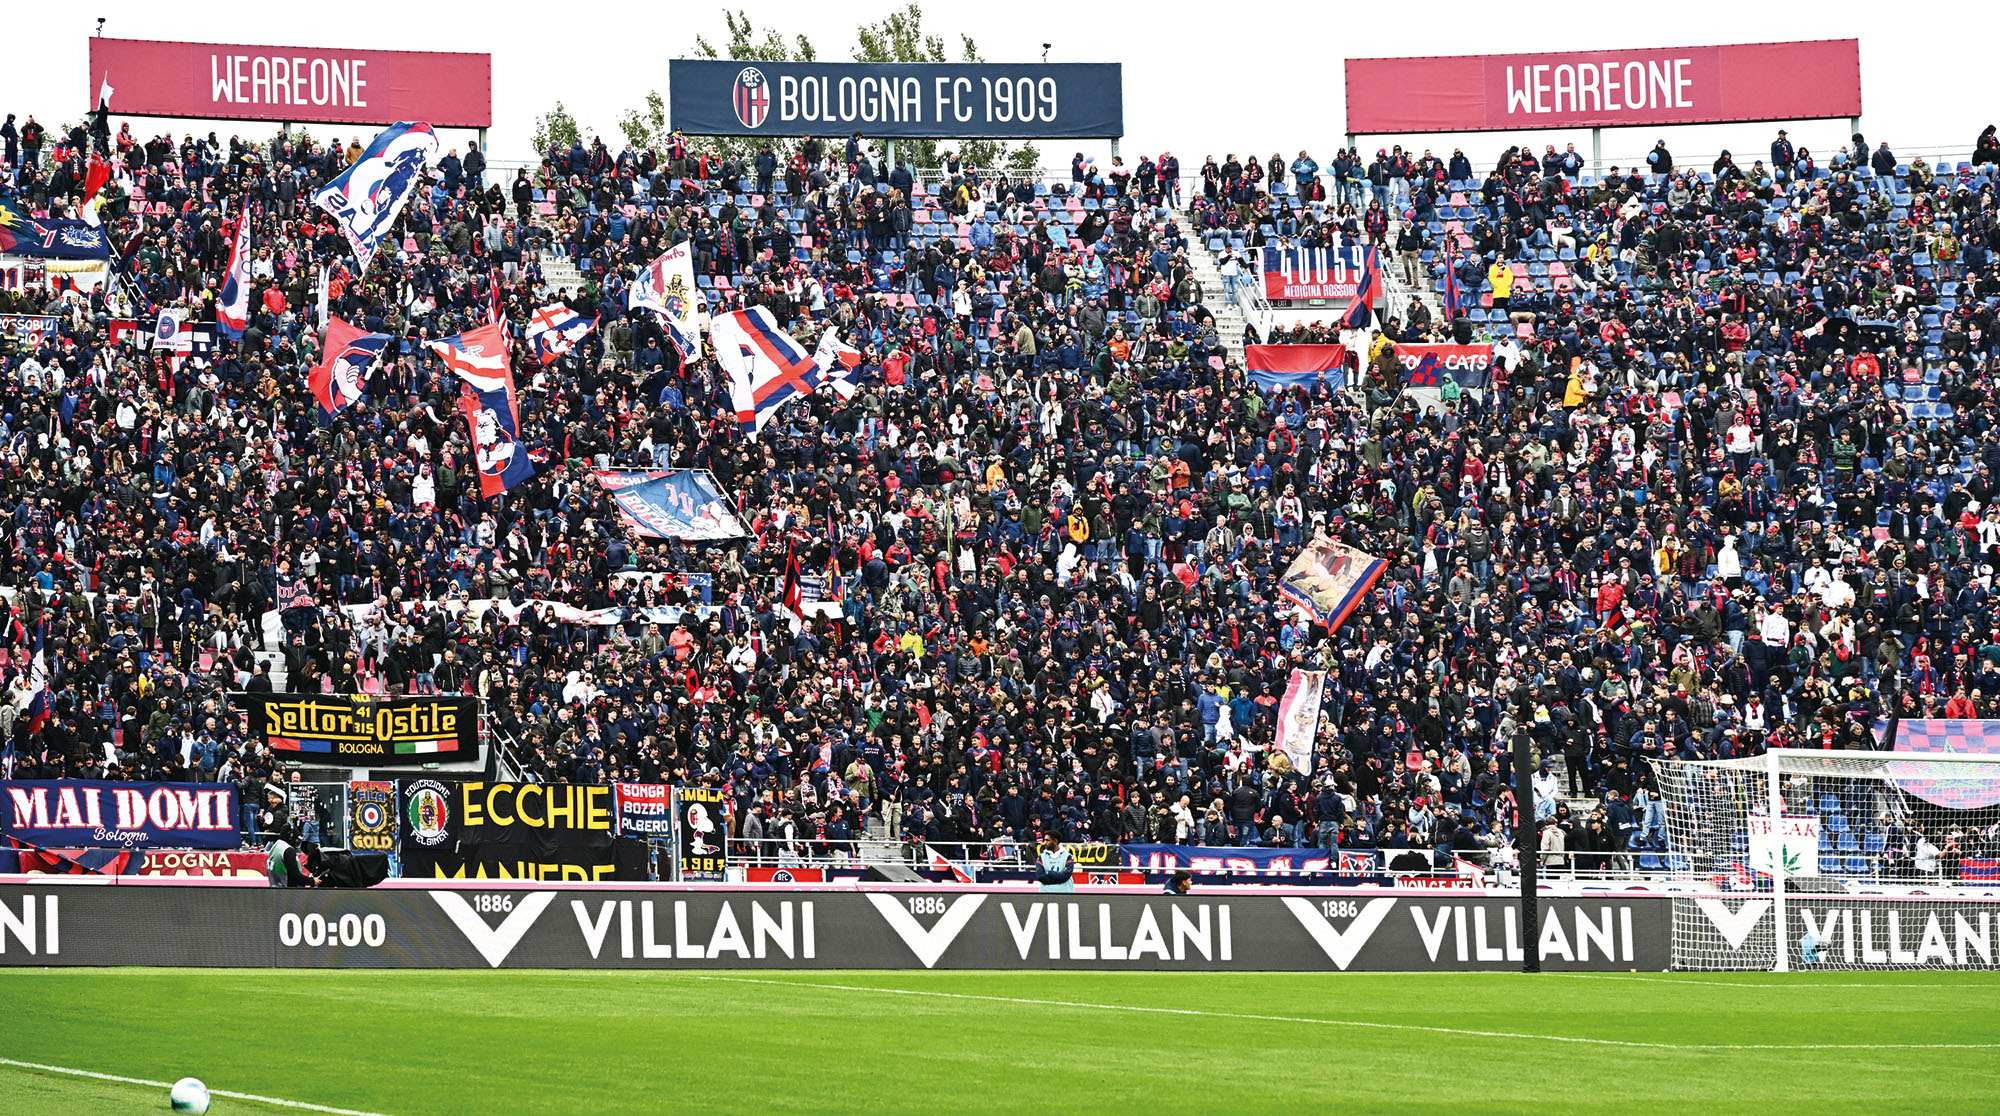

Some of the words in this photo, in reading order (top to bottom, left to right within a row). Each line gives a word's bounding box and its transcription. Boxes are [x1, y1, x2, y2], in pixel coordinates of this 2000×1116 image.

[211, 54, 367, 107] WEAREONE
[742, 70, 760, 82] BFC
[1506, 58, 1693, 114] WEAREONE
[780, 76, 921, 122] BOLOGNA
[935, 77, 973, 122] FC
[981, 77, 1057, 122] 1909
[46, 263, 103, 273] ORMENTERA
[1280, 247, 1365, 284] 40059
[1284, 285, 1321, 297] MEDICINA
[1398, 355, 1439, 371] FO
[1445, 354, 1488, 372] CATS
[264, 700, 352, 736] Settor
[376, 703, 457, 741] Ostile
[356, 706, 371, 718] 41
[338, 742, 384, 754] BOLOGNA
[351, 781, 391, 792] PRIMA
[404, 779, 451, 798] EDUCAZIONE
[622, 784, 665, 798] SONGA
[357, 791, 385, 802] FILA
[455, 781, 610, 830] ECCHIE
[7, 787, 105, 830] MAI
[112, 787, 233, 831] DOMI
[623, 801, 665, 815] BOZZA
[621, 817, 669, 832] ALBERO
[1750, 820, 1818, 838] FREAK
[352, 835, 393, 849] GOLD
[410, 831, 449, 846] FELSINEA
[141, 853, 231, 869] OLOGNA
[681, 857, 726, 871] 1987
[474, 895, 513, 913] 1886
[908, 897, 946, 915] 1886
[1321, 900, 1359, 918] 1886
[279, 913, 386, 947] 00:00
[570, 900, 815, 959] VILLANI
[1000, 902, 1232, 962] VILLANI
[1409, 905, 1634, 962] VILLANI
[1800, 908, 2000, 965] VILLAN
